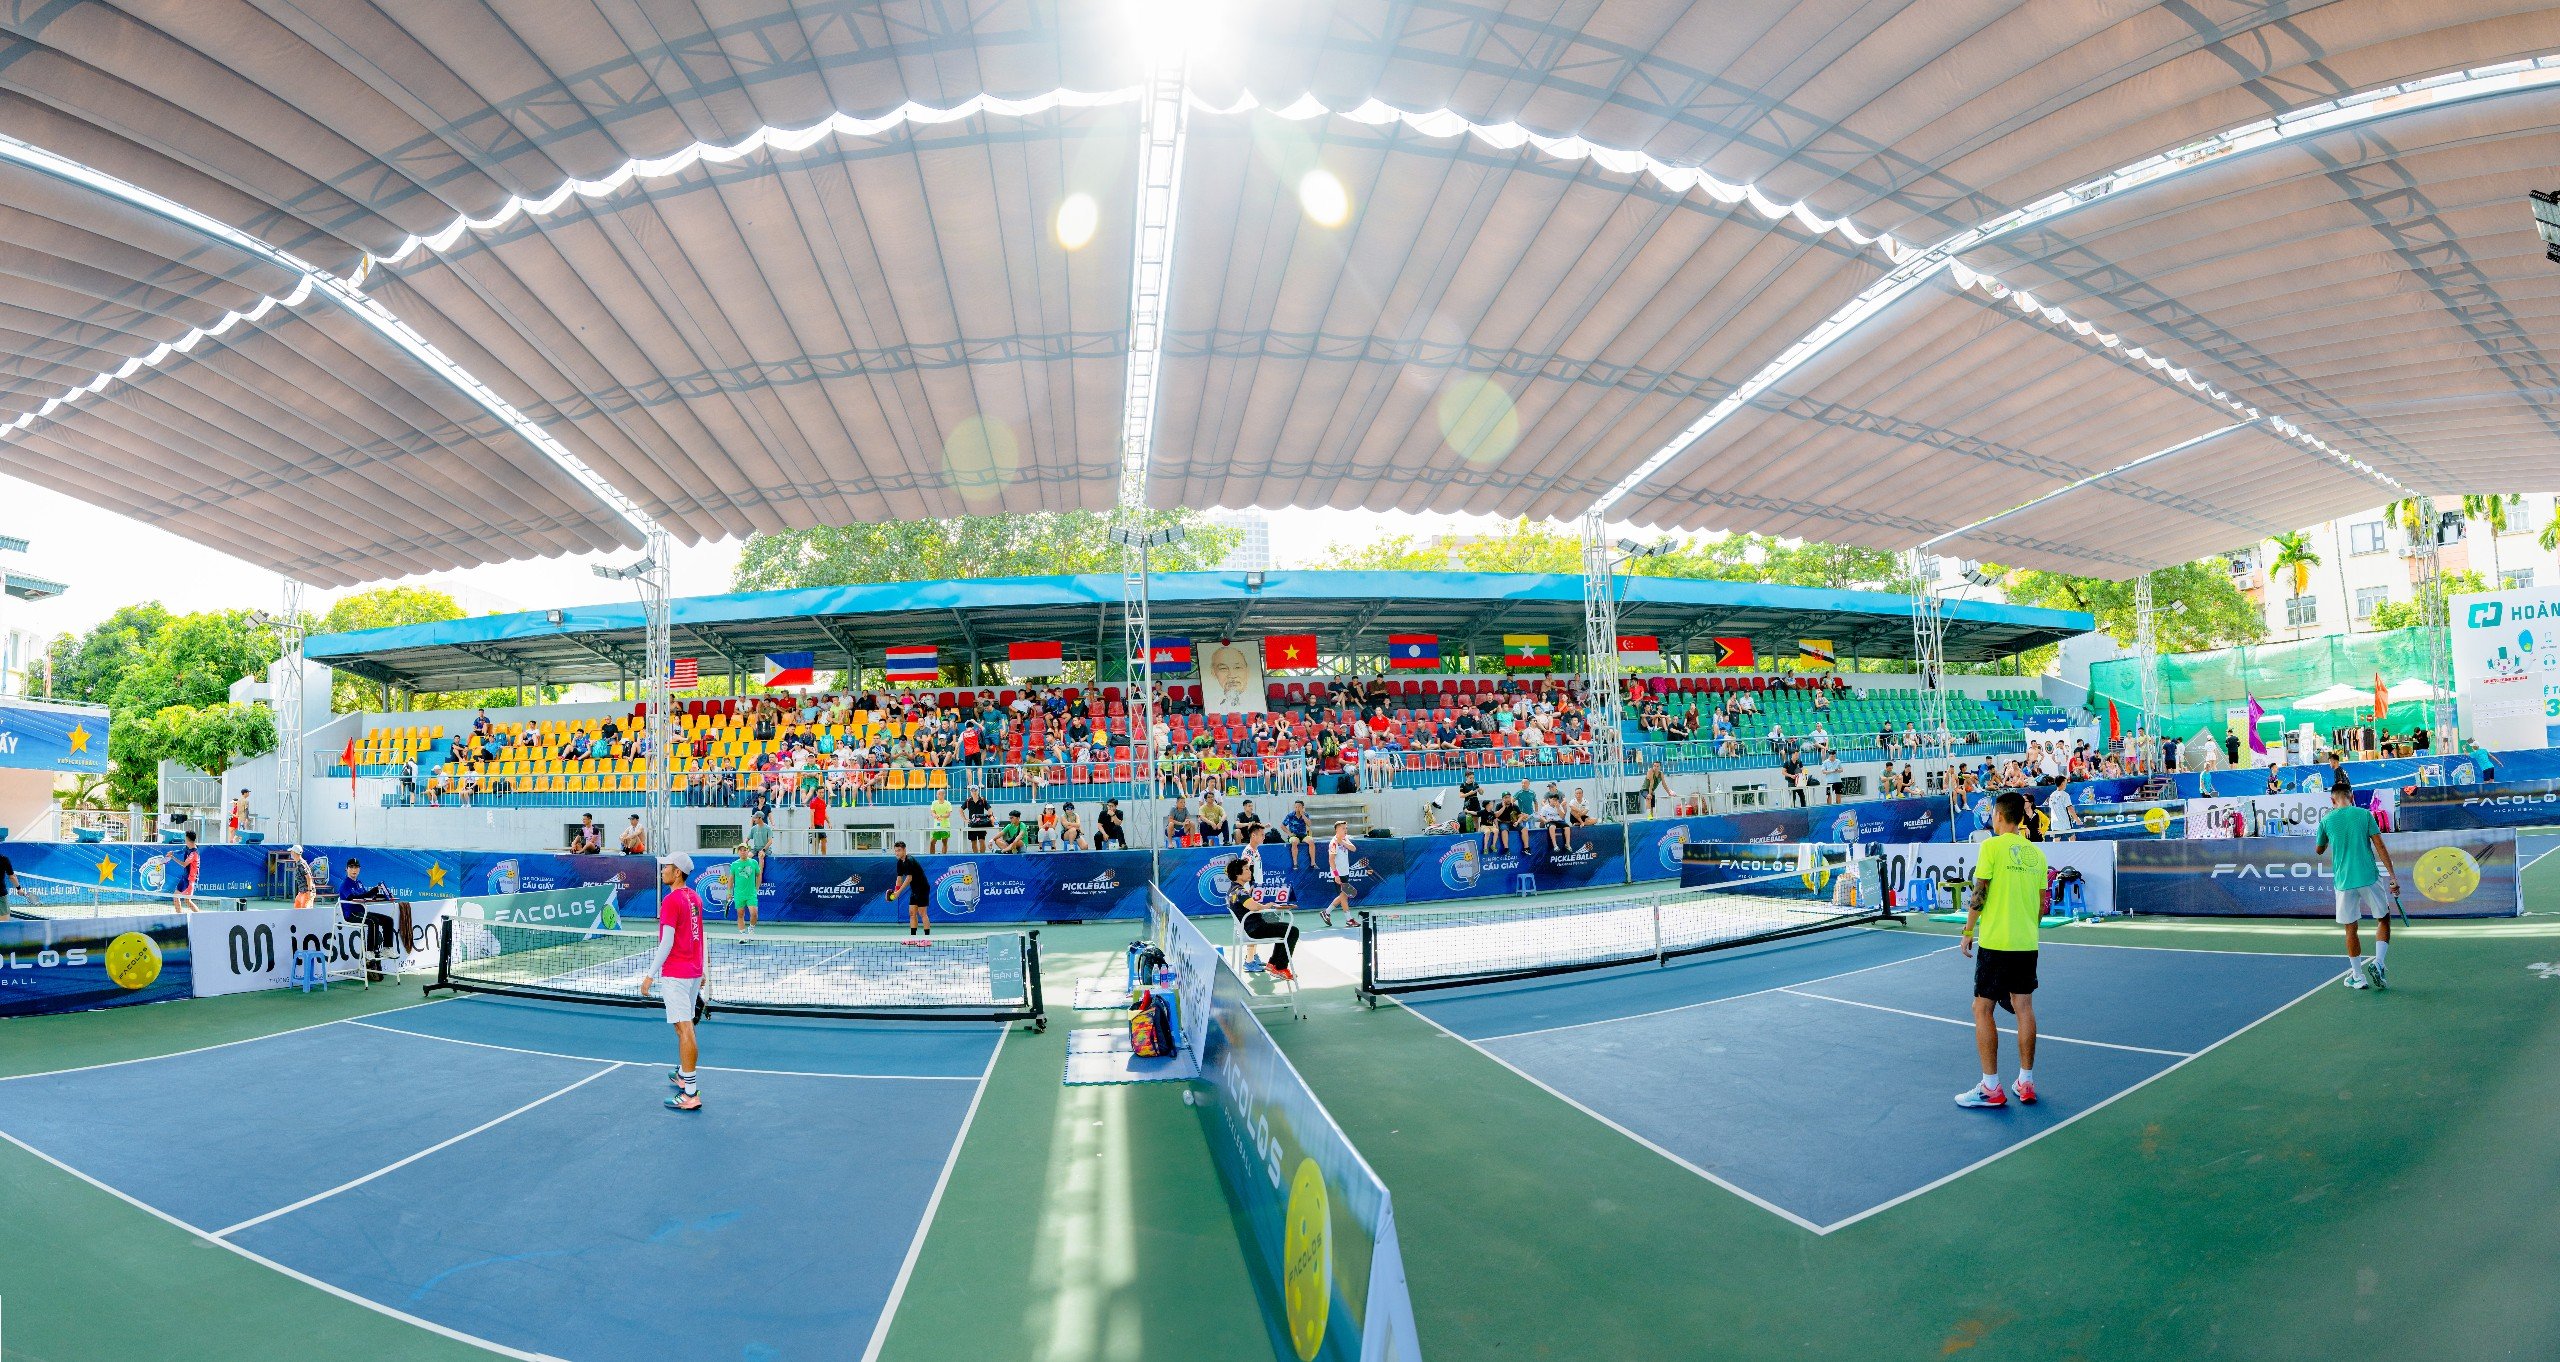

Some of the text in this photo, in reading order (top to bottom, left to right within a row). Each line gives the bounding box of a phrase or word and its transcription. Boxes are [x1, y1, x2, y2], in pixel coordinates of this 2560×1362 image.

[2463, 793, 2557, 807] FACOLO
[1749, 835, 1785, 844] PICKLEBALL
[1550, 852, 1594, 863] PICKLEBALL
[1719, 860, 1795, 871] FACOLOS
[2427, 860, 2464, 892] FACOLOS
[984, 886, 1002, 896] CẦU
[1004, 885, 1026, 895] GIẤY
[1062, 881, 1115, 891] PICKLEBALL
[1253, 890, 1263, 901] 3
[1277, 890, 1288, 902] 6
[119, 946, 148, 980] FACOLOS
[1288, 1232, 1322, 1287] FACOLOS
